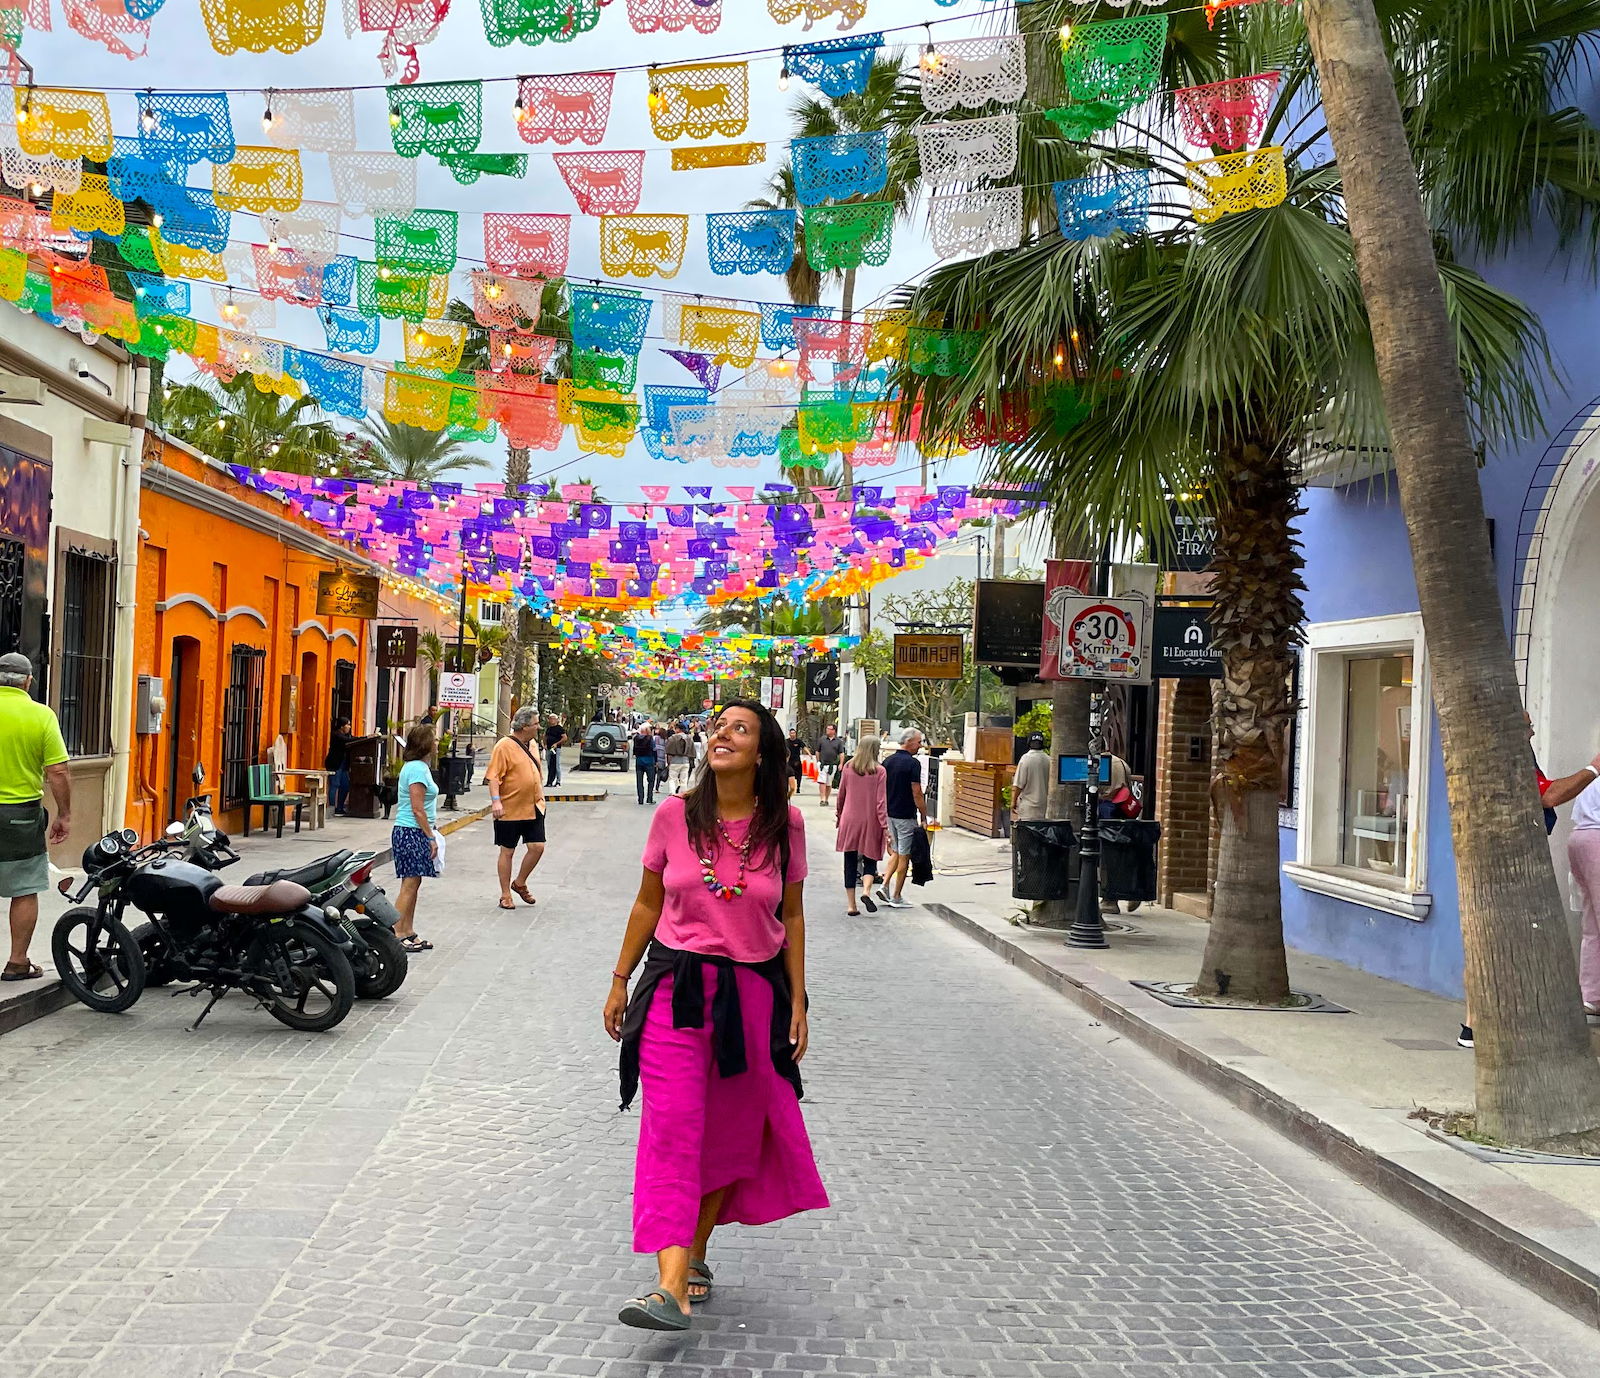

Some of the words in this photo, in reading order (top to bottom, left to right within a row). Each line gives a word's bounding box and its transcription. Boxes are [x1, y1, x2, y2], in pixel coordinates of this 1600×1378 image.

[1087, 615, 1118, 640] 30
[1163, 646, 1173, 657] El
[1174, 646, 1208, 657] Encanto
[1209, 648, 1223, 657] Inn
